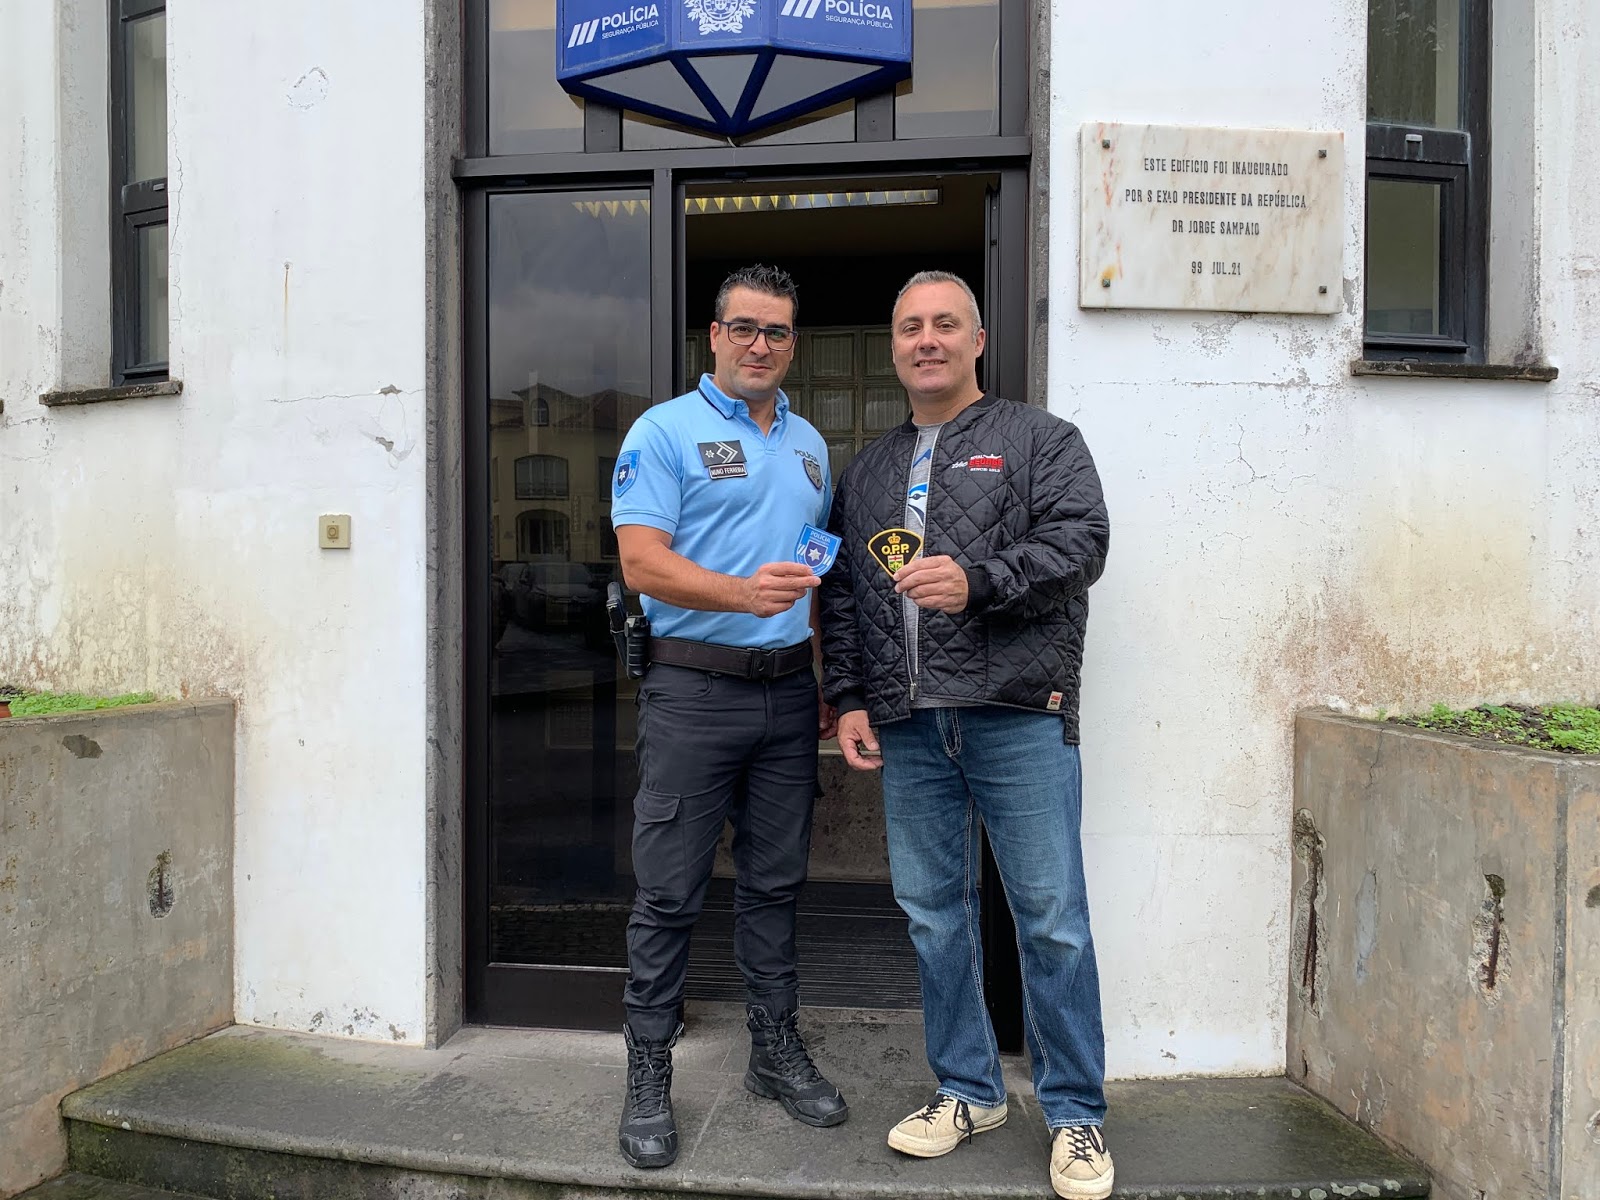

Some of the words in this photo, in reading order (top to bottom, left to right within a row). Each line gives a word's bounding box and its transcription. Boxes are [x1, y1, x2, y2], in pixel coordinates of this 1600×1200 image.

[601, 3, 659, 31] POLÍCIA
[825, 0, 894, 21] POLÍCIA
[601, 25, 635, 40] SEGURANÇA
[635, 19, 659, 31] PÚBLICA
[825, 14, 866, 26] SEGURANÇA
[866, 19, 894, 29] PÚBLICA
[1144, 158, 1167, 172] ESTE
[1213, 160, 1228, 174] FOI
[1232, 161, 1288, 176] INAUGURADO
[1125, 188, 1143, 203] POR
[1182, 190, 1237, 206] PRESIDENTE
[1241, 193, 1253, 207] DA
[1257, 189, 1307, 208] REPÚBLICA
[1172, 219, 1184, 233] DR
[1188, 220, 1216, 234] JORGE
[1220, 221, 1260, 236] SAMPAIO
[1191, 260, 1203, 274] 99
